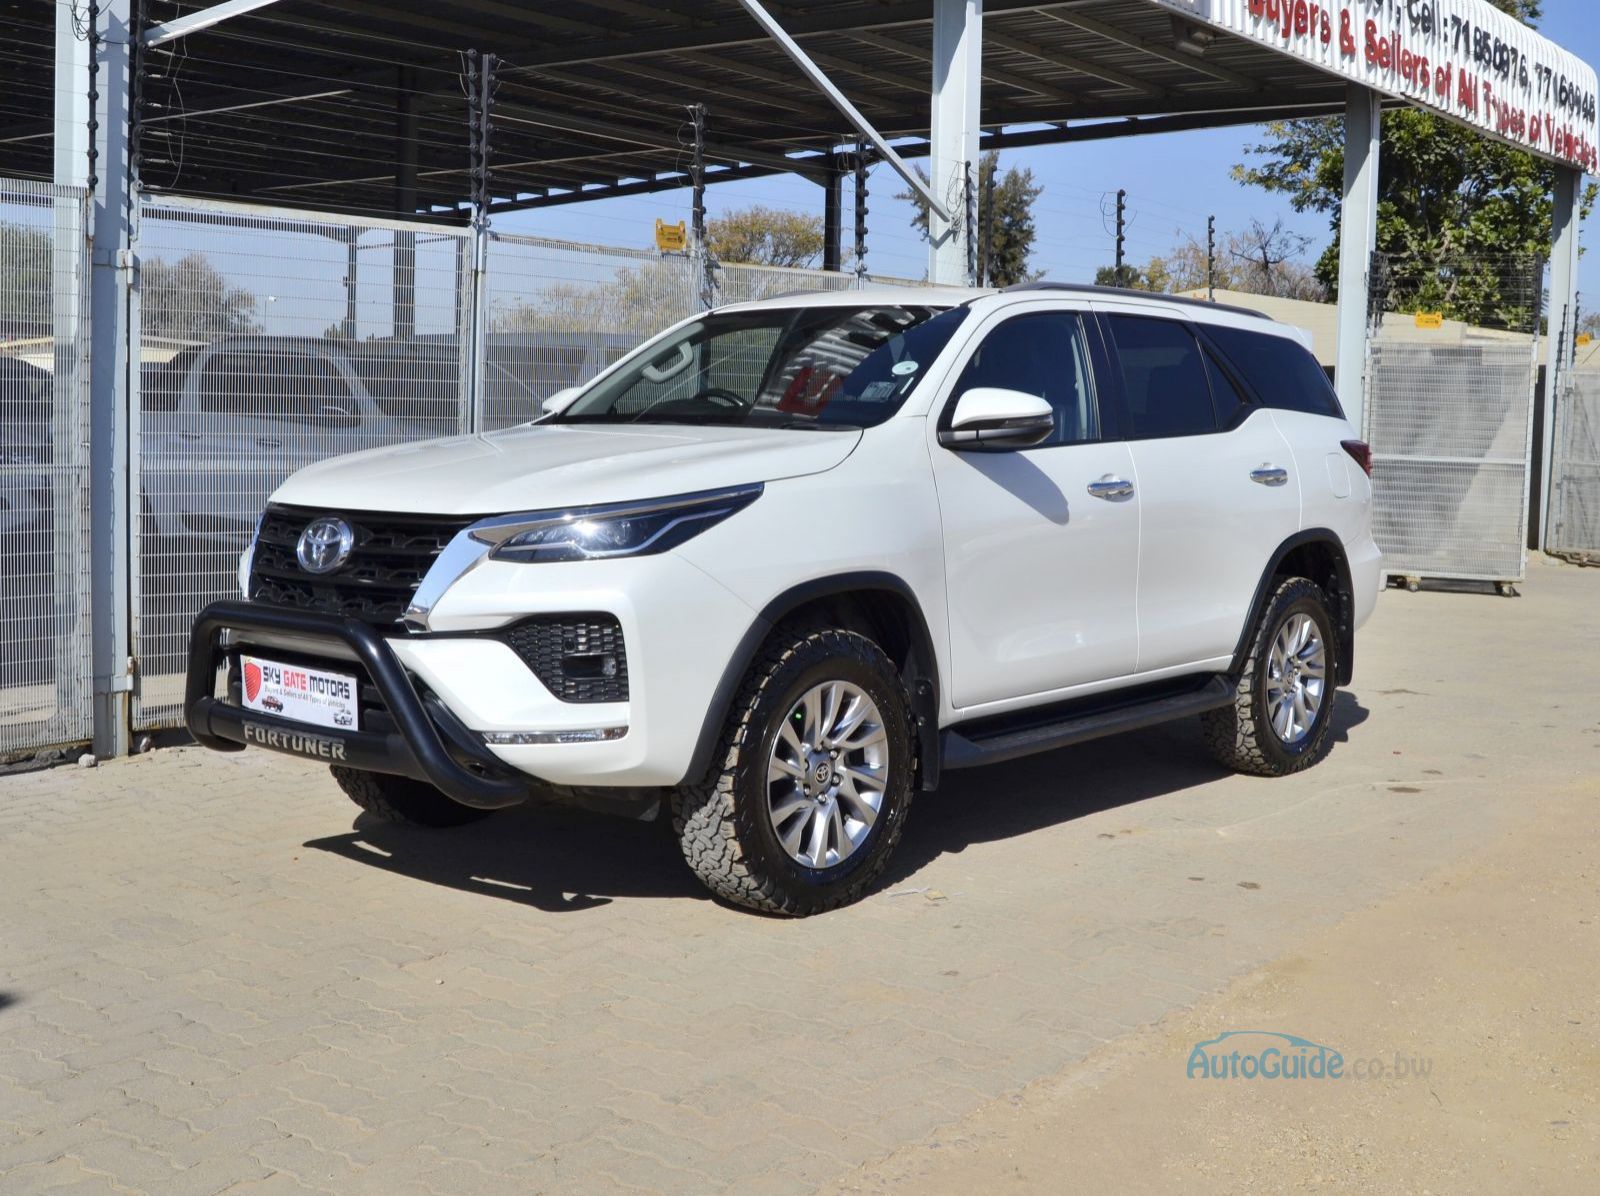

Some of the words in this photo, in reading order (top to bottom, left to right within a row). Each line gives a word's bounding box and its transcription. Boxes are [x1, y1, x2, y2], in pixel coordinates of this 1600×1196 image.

[1340, 8, 1356, 54] &
[1365, 19, 1430, 89] Sellers
[1435, 61, 1451, 100] of
[1458, 68, 1478, 116] All
[1482, 80, 1525, 137] Types
[1529, 110, 1542, 143] of
[1545, 113, 1597, 170] Vehicles
[262, 666, 280, 685] SKY
[283, 670, 307, 690] GATE
[309, 675, 350, 700] MOTORS
[243, 724, 346, 761] FORTUNER
